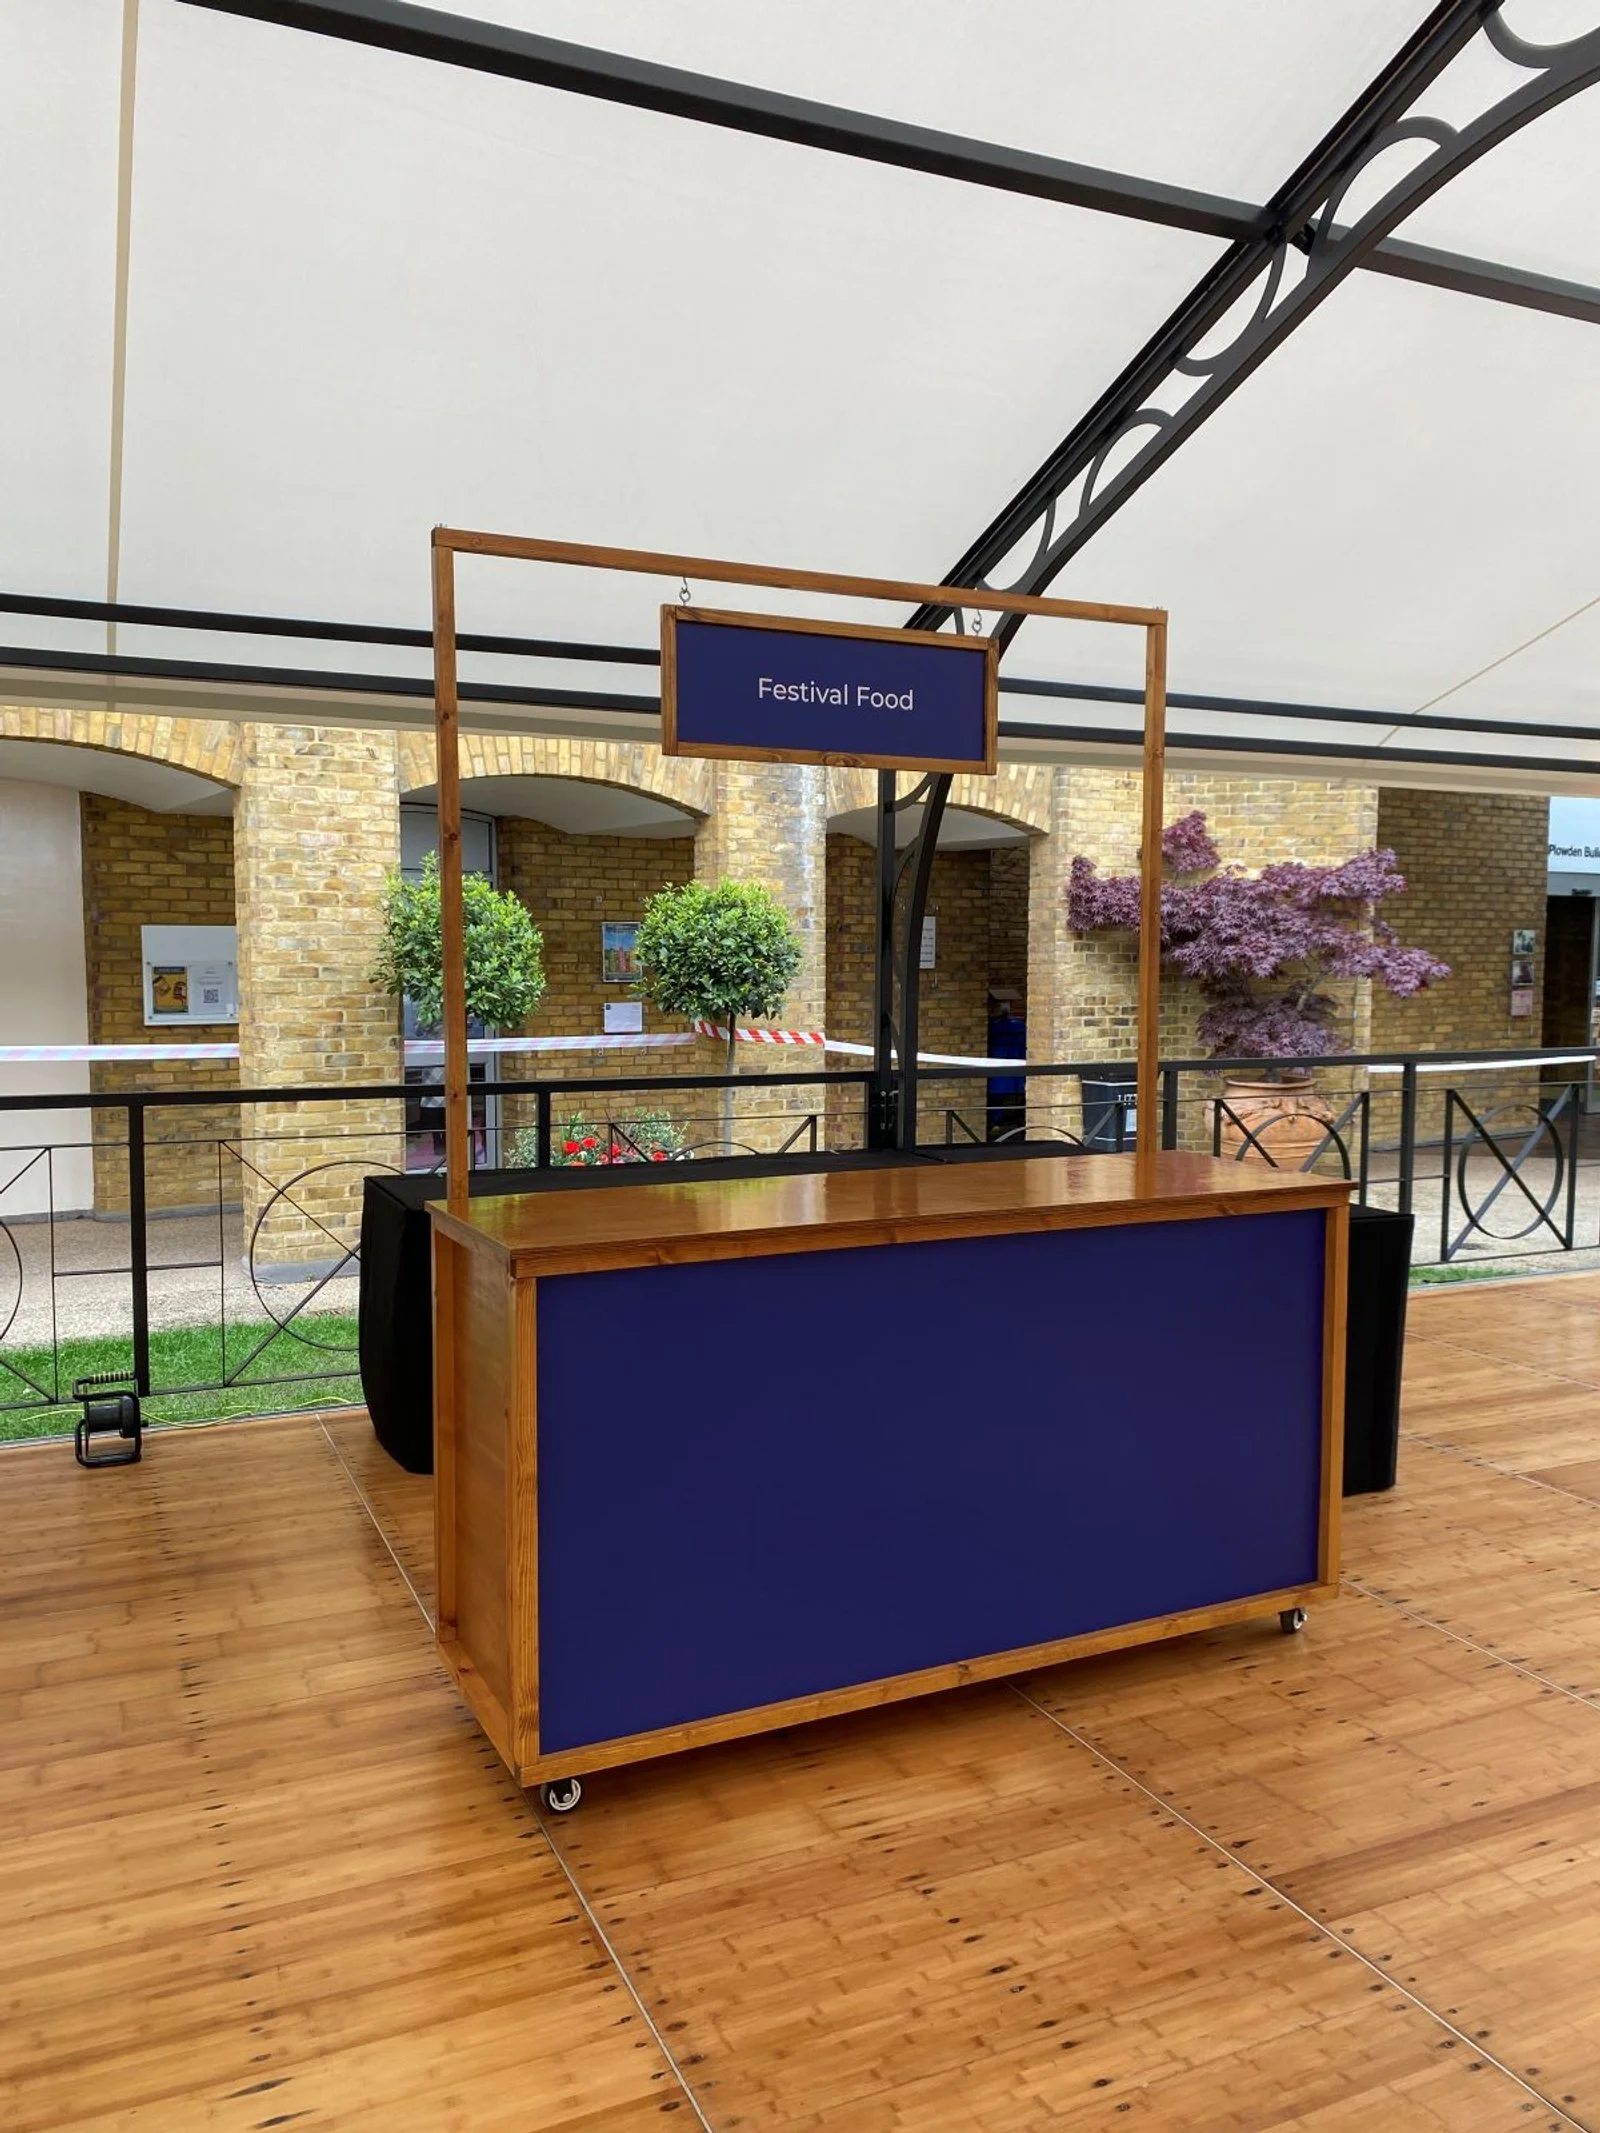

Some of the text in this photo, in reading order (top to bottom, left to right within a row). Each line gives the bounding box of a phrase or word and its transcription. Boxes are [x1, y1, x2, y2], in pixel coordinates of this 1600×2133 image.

[758, 677, 914, 711] Festival Food
[1549, 844, 1582, 857] Plowden
